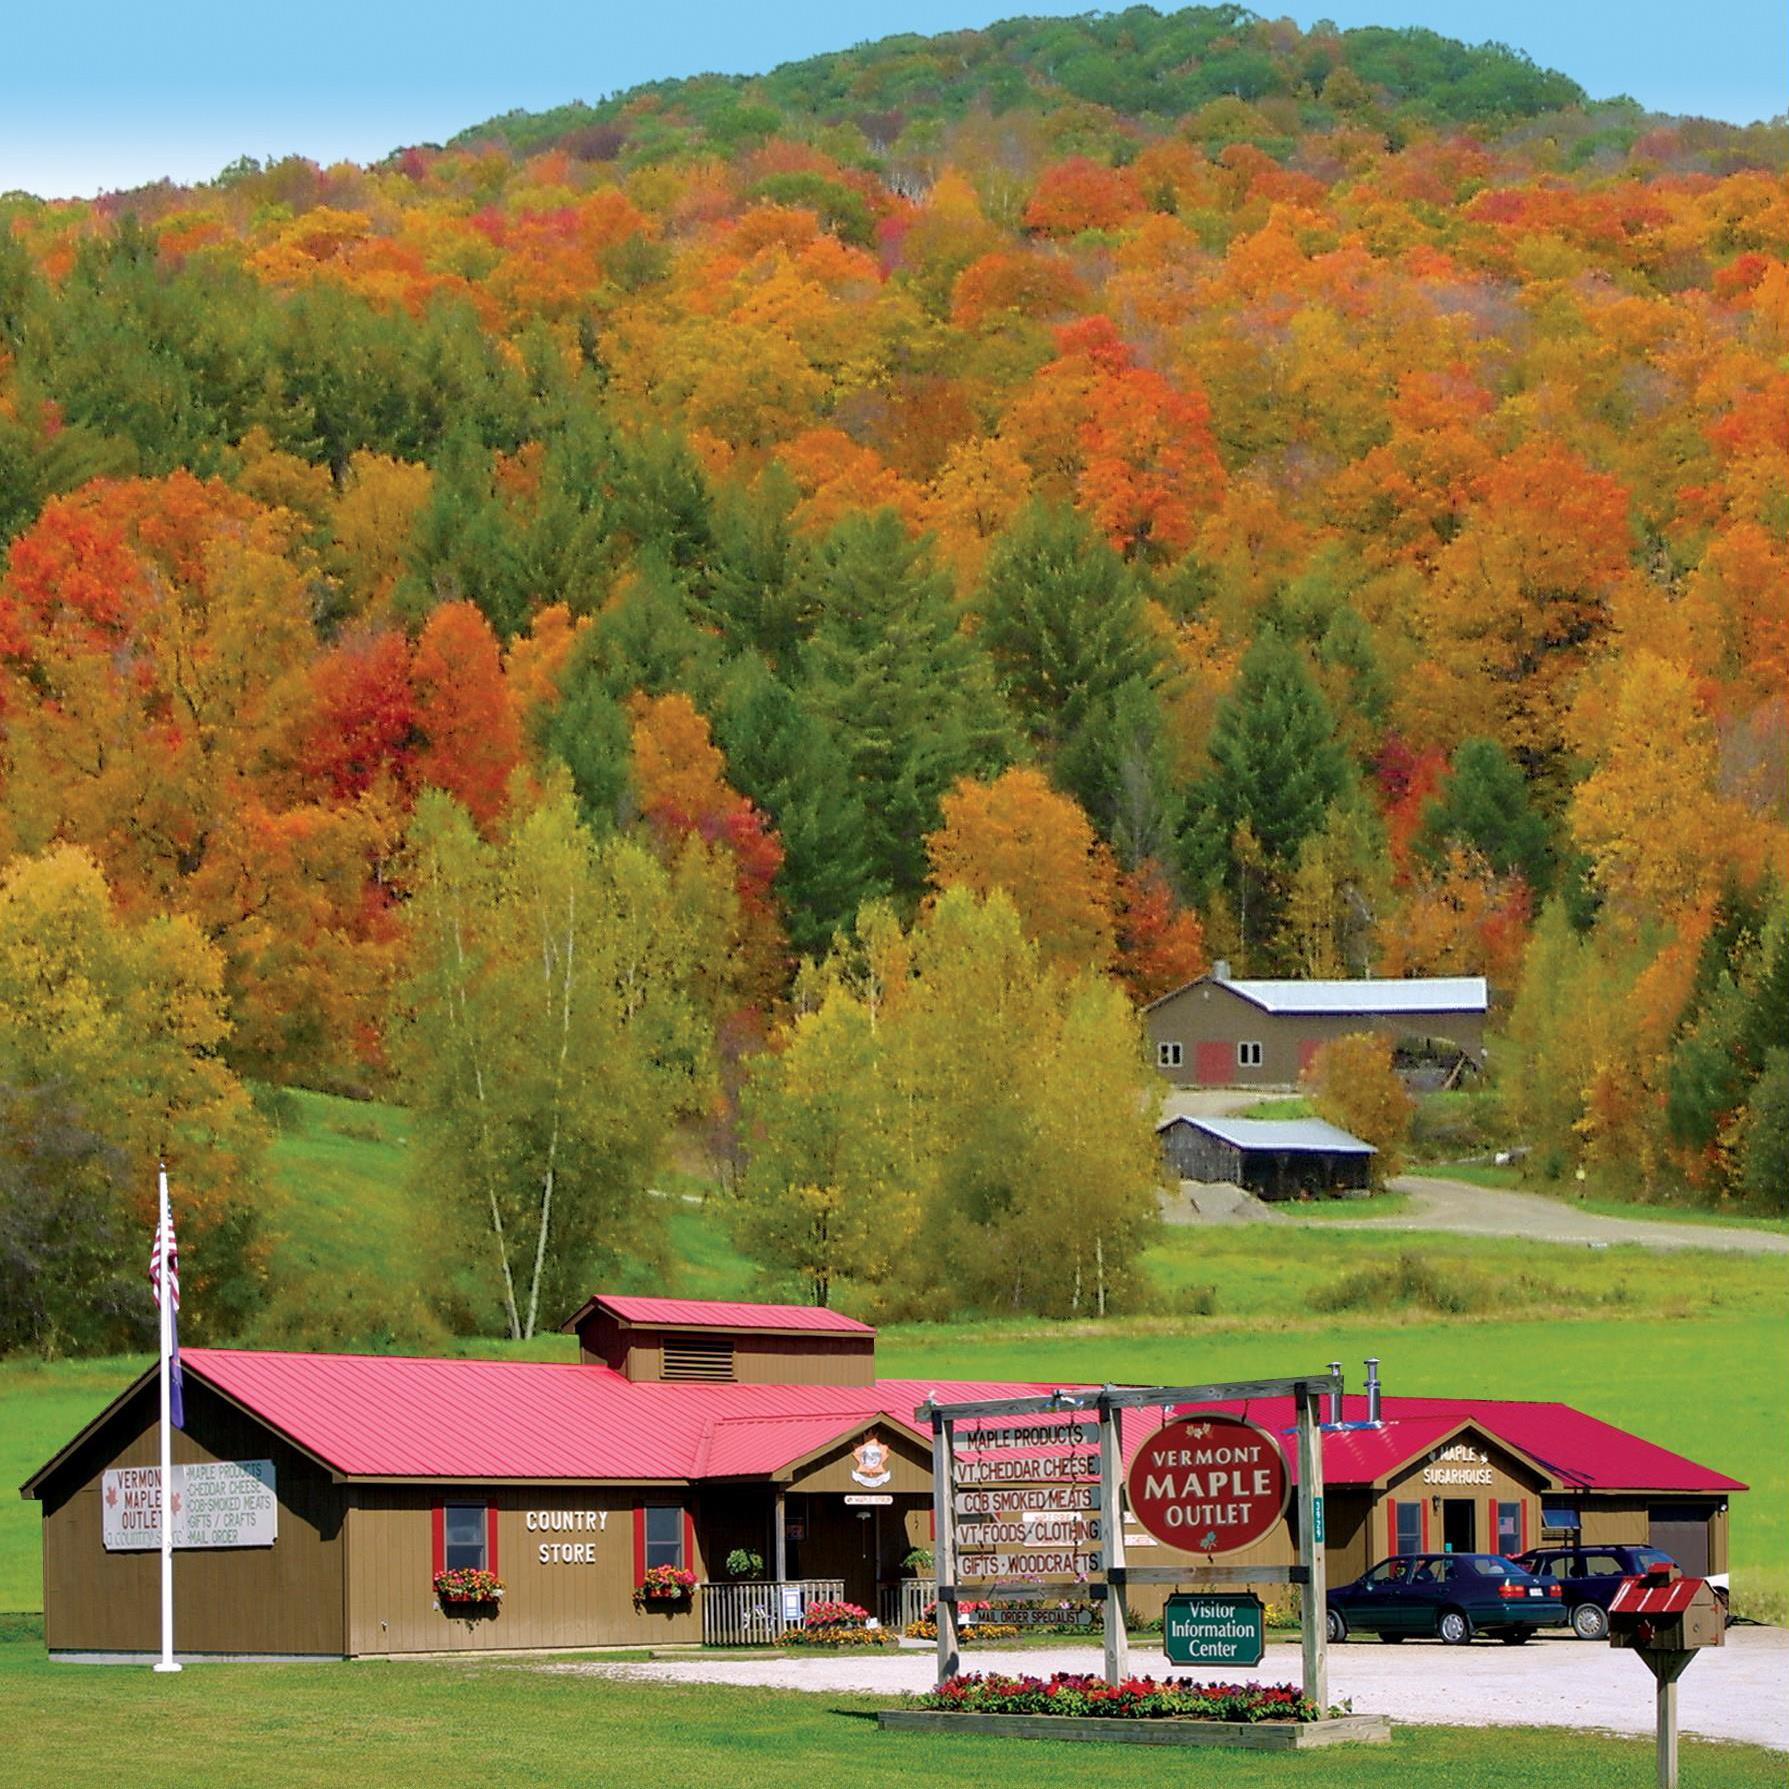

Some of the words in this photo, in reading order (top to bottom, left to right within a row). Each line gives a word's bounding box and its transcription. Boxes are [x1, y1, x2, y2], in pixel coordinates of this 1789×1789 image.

[968, 1430, 1010, 1450] MAPLE
[1014, 1425, 1083, 1446] PRODUCTS
[1153, 1446, 1261, 1467] VERMONT
[1439, 1445, 1476, 1462] MAPLE
[980, 1460, 1040, 1480] CHEDDAR
[1044, 1456, 1096, 1476] CHEESE
[1423, 1468, 1493, 1485] SUGARHOUSE
[117, 1469, 162, 1489] VERMON
[1144, 1469, 1271, 1500] MAPLE
[124, 1490, 162, 1509] MAPLE
[964, 1494, 990, 1512] COB
[993, 1491, 1045, 1510] SMOKED
[1048, 1489, 1092, 1508] MEATS
[224, 1512, 256, 1527] CRAFTS
[526, 1511, 608, 1532] COUNTRY
[1165, 1503, 1252, 1527] OUTLET
[983, 1524, 1025, 1542] FOODS
[1035, 1520, 1099, 1540] CLOTHING
[539, 1543, 596, 1564] STORE
[962, 1556, 999, 1574] GIFTS
[1008, 1553, 1098, 1573] WOODCRAFTS
[978, 1611, 997, 1623] MAIL
[1001, 1611, 1029, 1623] ORDER
[1031, 1611, 1081, 1623] SPECIALIST
[1190, 1601, 1236, 1619] Visitor
[1171, 1620, 1255, 1638] Information
[1189, 1640, 1237, 1657] Center
